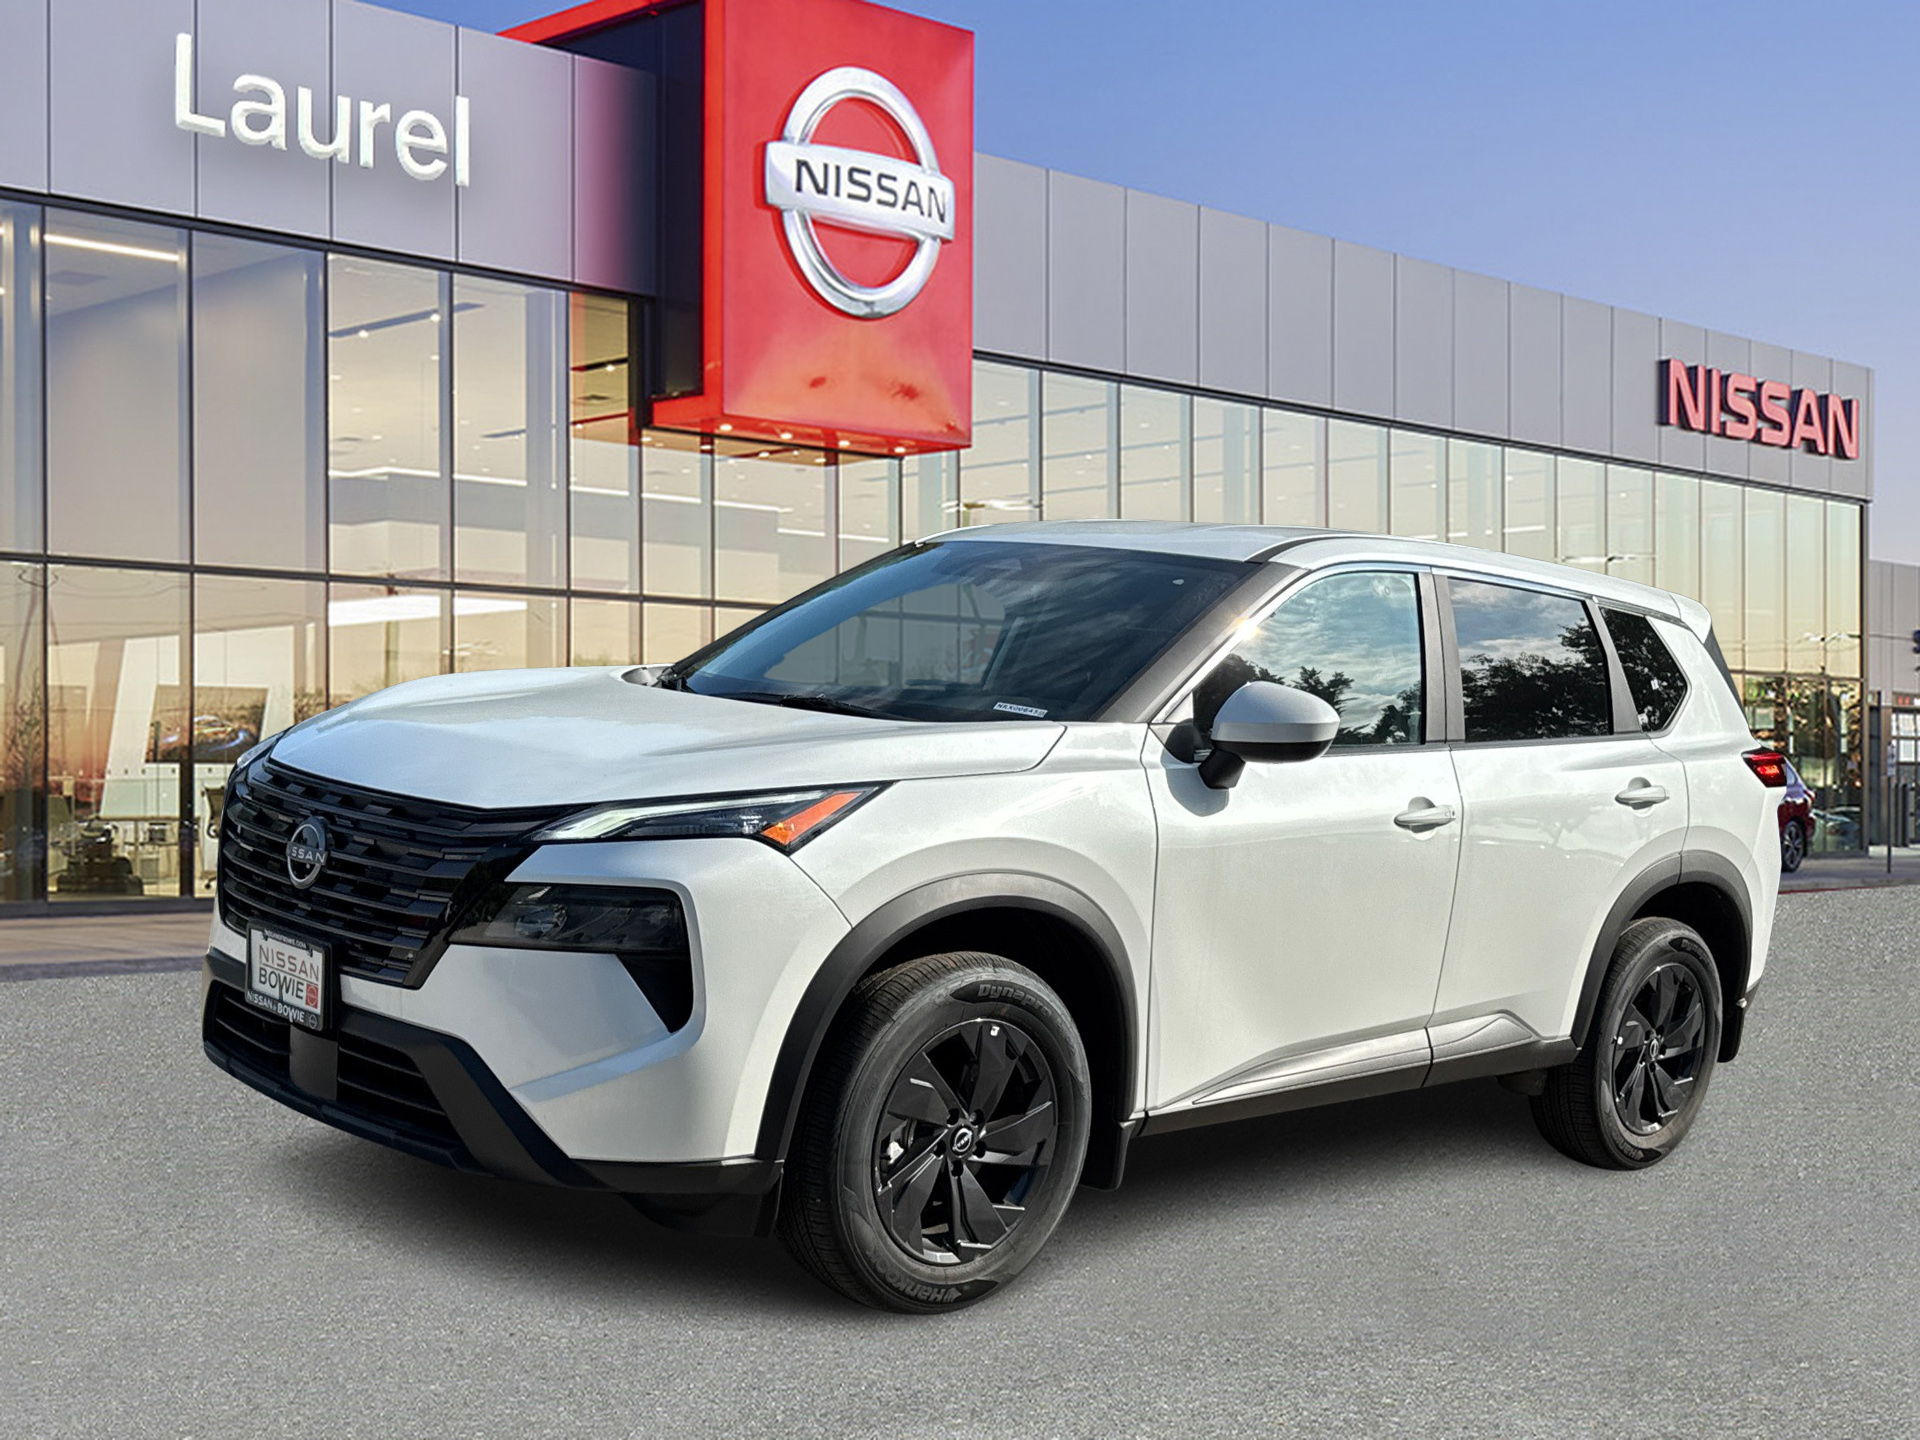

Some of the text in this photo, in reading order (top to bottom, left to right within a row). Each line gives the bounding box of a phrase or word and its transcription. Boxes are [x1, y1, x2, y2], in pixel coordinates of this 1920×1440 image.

[175, 32, 470, 188] Laurel
[795, 158, 946, 223] NISSAN
[1658, 358, 1860, 460] NISSAN
[259, 944, 319, 982] NISSAN
[259, 967, 304, 1000] BOWIE
[247, 990, 273, 1011] NISSAN
[277, 1002, 305, 1023] BOWIE
